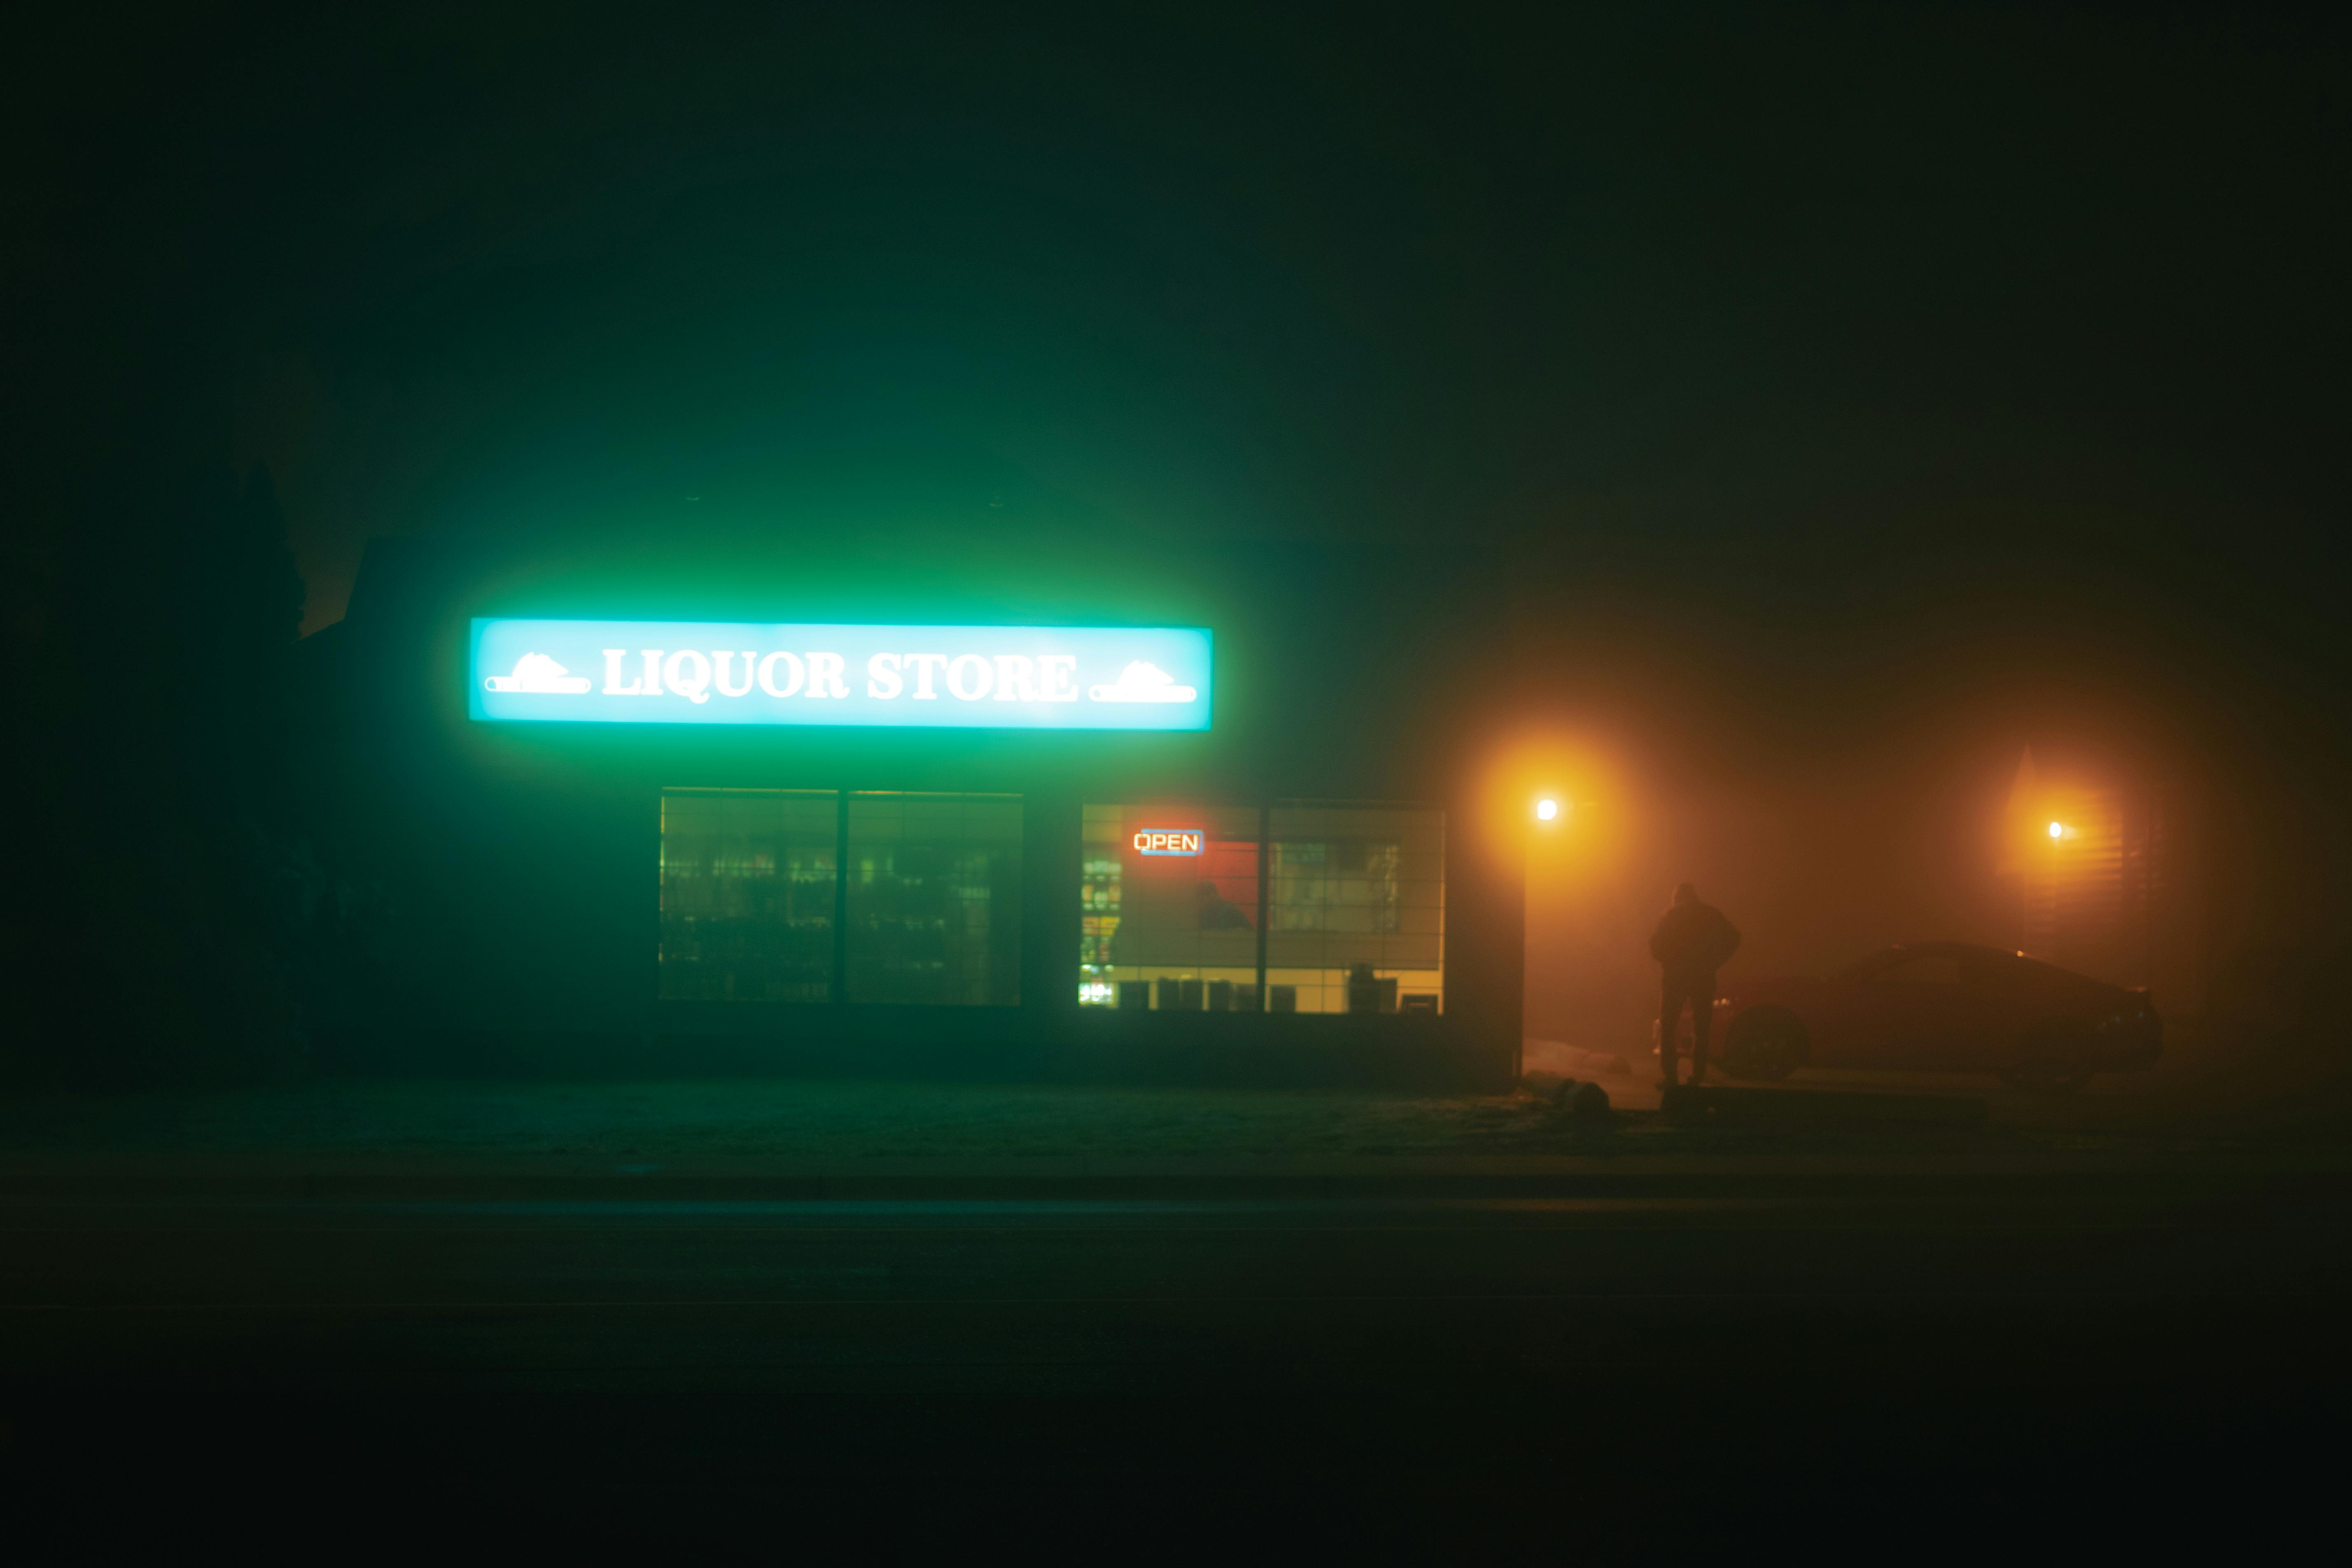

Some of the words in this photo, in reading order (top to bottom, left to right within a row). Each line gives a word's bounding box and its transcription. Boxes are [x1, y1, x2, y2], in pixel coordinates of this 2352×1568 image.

[602, 649, 850, 704] LIQUOR
[867, 653, 1079, 702] STORE
[1134, 833, 1198, 851] OPEN
